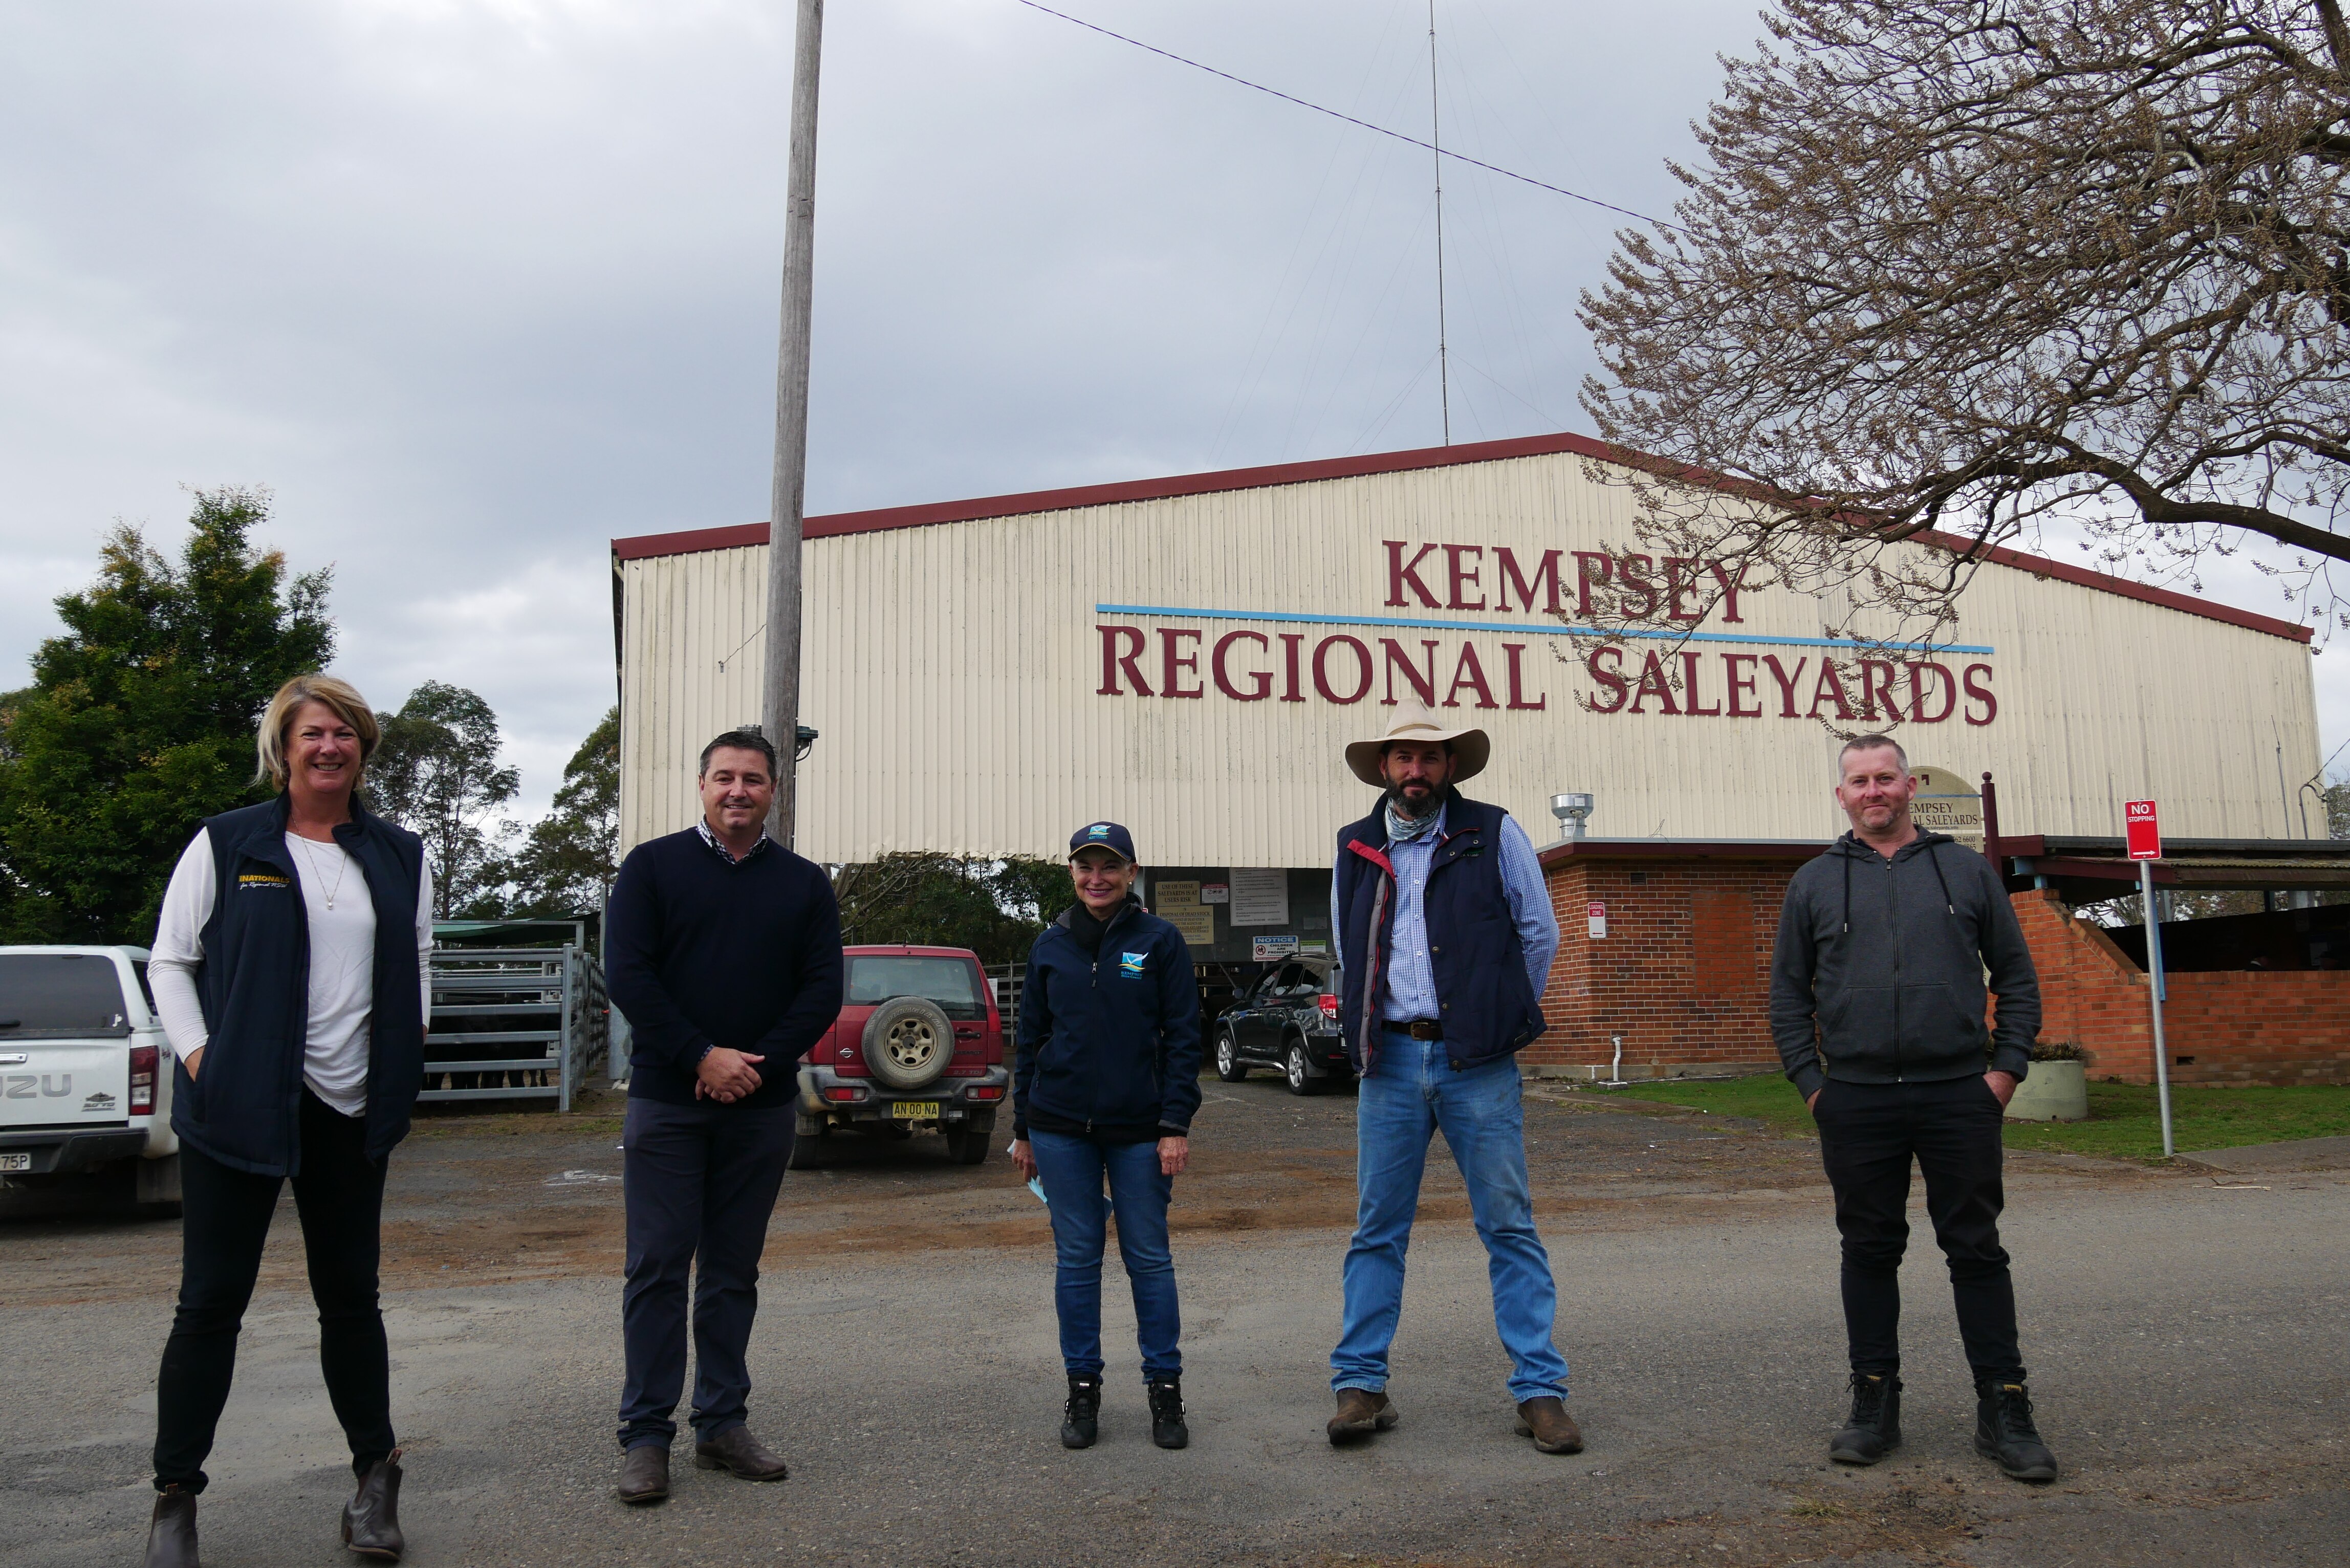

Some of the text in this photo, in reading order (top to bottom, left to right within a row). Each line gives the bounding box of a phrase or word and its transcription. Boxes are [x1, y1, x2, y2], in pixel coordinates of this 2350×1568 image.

[1382, 540, 1750, 623] KEMPSEY
[1095, 624, 1997, 726] REGIONAL SALEYARDS
[1909, 803, 1953, 813] EMPSEY
[2131, 804, 2149, 815] NO
[1926, 814, 1978, 825] SALEYARDS
[242, 875, 290, 883] NATIONALS
[0, 1074, 71, 1099] ZU
